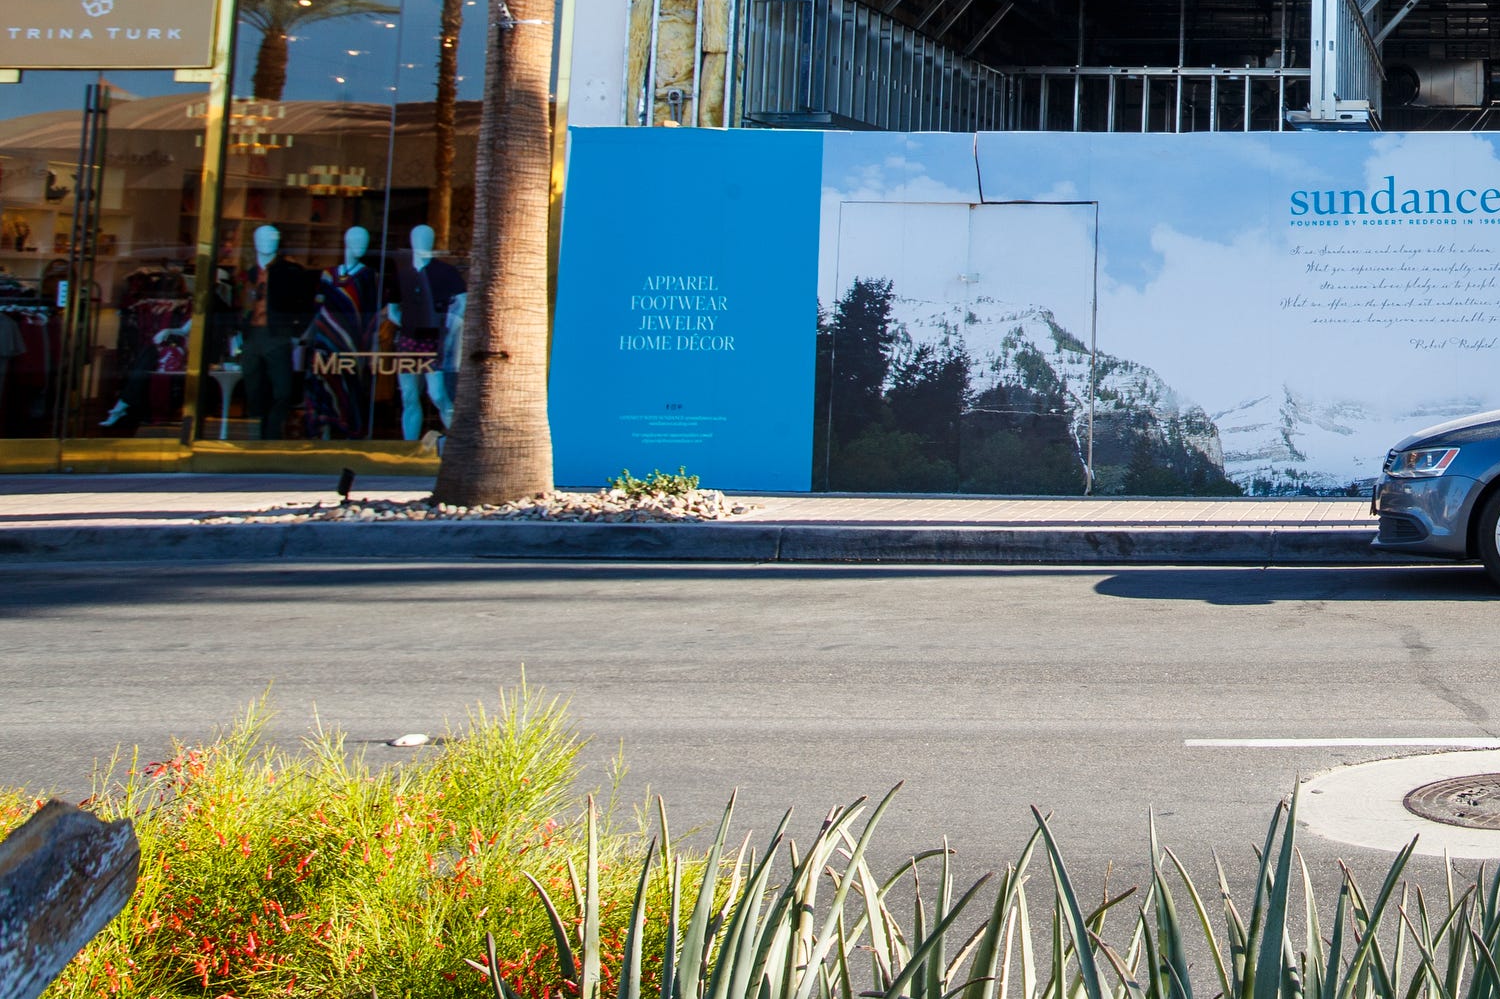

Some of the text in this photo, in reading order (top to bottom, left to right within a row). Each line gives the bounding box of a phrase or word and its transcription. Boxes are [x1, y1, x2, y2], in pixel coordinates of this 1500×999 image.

[8, 27, 182, 40] TRINA TURK
[1305, 259, 1330, 274] What
[643, 275, 719, 291] APPAREL
[631, 295, 729, 311] FOOTWEAR
[638, 315, 719, 331] JEWELRY
[619, 332, 736, 351] HOME DÉCOR
[1410, 337, 1498, 352] Robert Redford
[339, 352, 438, 375] TURK
